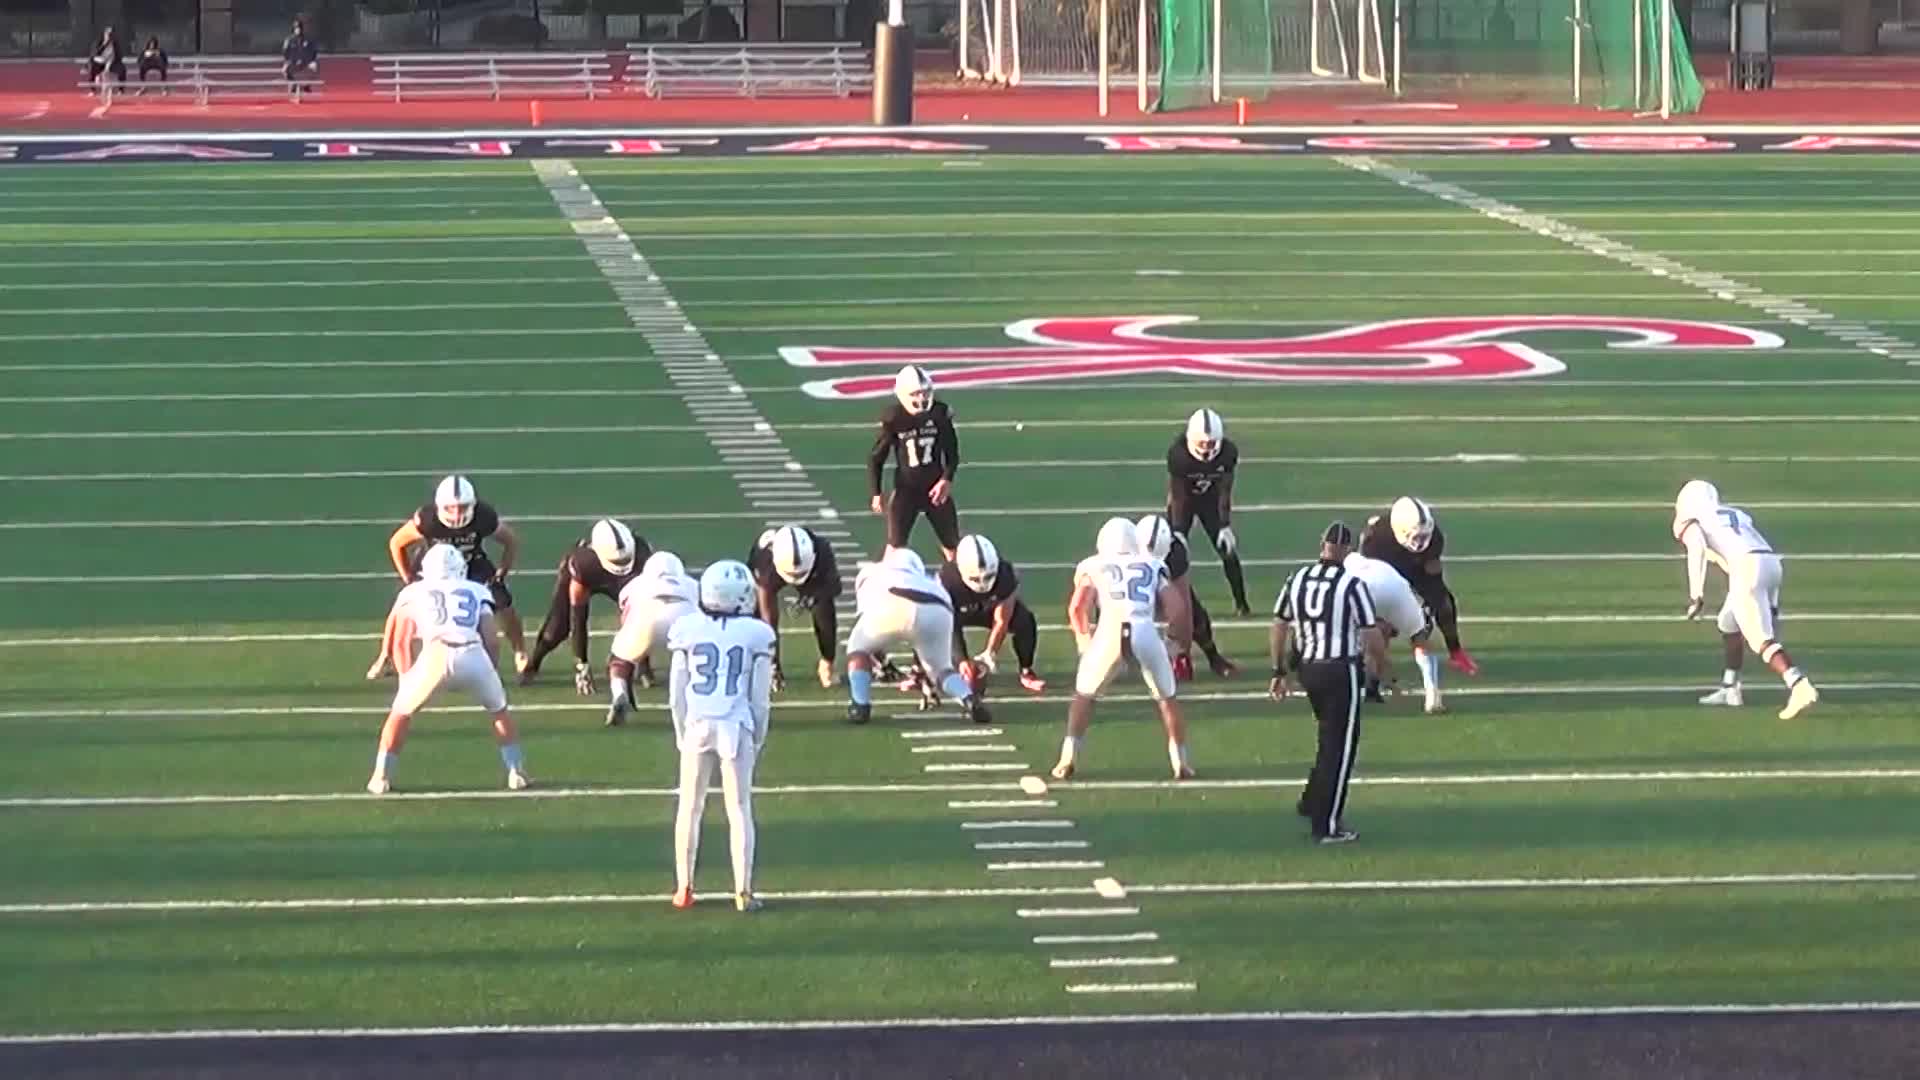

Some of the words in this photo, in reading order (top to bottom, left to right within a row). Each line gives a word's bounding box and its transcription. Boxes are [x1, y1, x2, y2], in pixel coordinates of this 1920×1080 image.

[0, 135, 988, 160] ANTA
[905, 431, 935, 467] 17
[1305, 580, 1331, 617] U
[691, 641, 744, 697] 31
